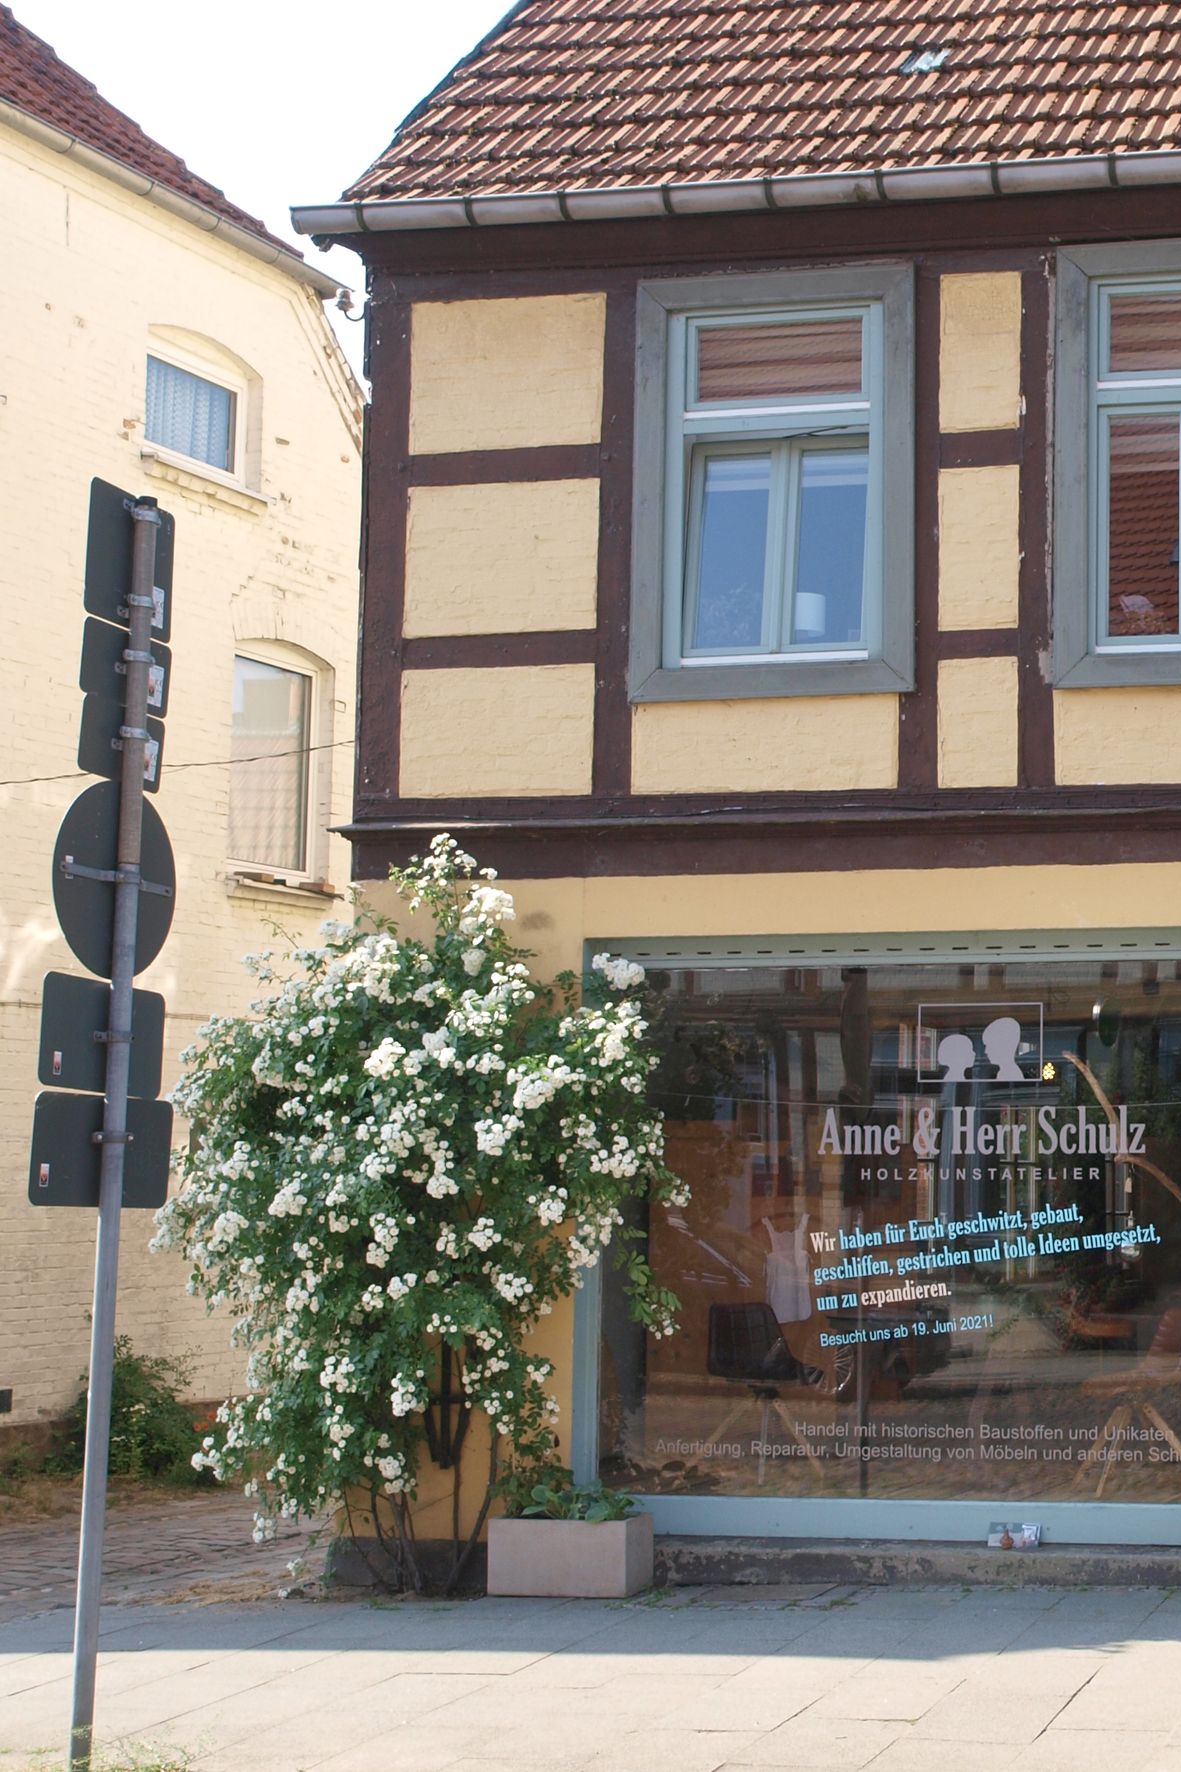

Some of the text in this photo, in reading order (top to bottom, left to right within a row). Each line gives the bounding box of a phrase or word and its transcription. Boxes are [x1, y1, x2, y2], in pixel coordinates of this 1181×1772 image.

[817, 1105, 1146, 1155] Anne & Herr Schulz
[860, 1167, 1101, 1181] HOLZKUNSTATELIER
[810, 1203, 1084, 1254] Wir haben für Euch geschwitzt, gebaut,
[813, 1224, 1162, 1286] geschliffen, gestrichen und tolle Ideen umgesetzt,
[816, 1281, 952, 1311] um zu expandieren.
[819, 1314, 994, 1348] Besucht uns ab 19. Juni 2021!
[794, 1421, 1175, 1442] Handel mit historischen Baustoffen und Unikaten
[655, 1439, 746, 1459] Anfertigung,
[751, 1441, 830, 1459] Reparatur,
[834, 1442, 942, 1462] Umgestaltung
[945, 1447, 975, 1460] von
[979, 1444, 1038, 1461] Möbeln
[1042, 1445, 1072, 1461] und
[1076, 1446, 1145, 1463] anderen
